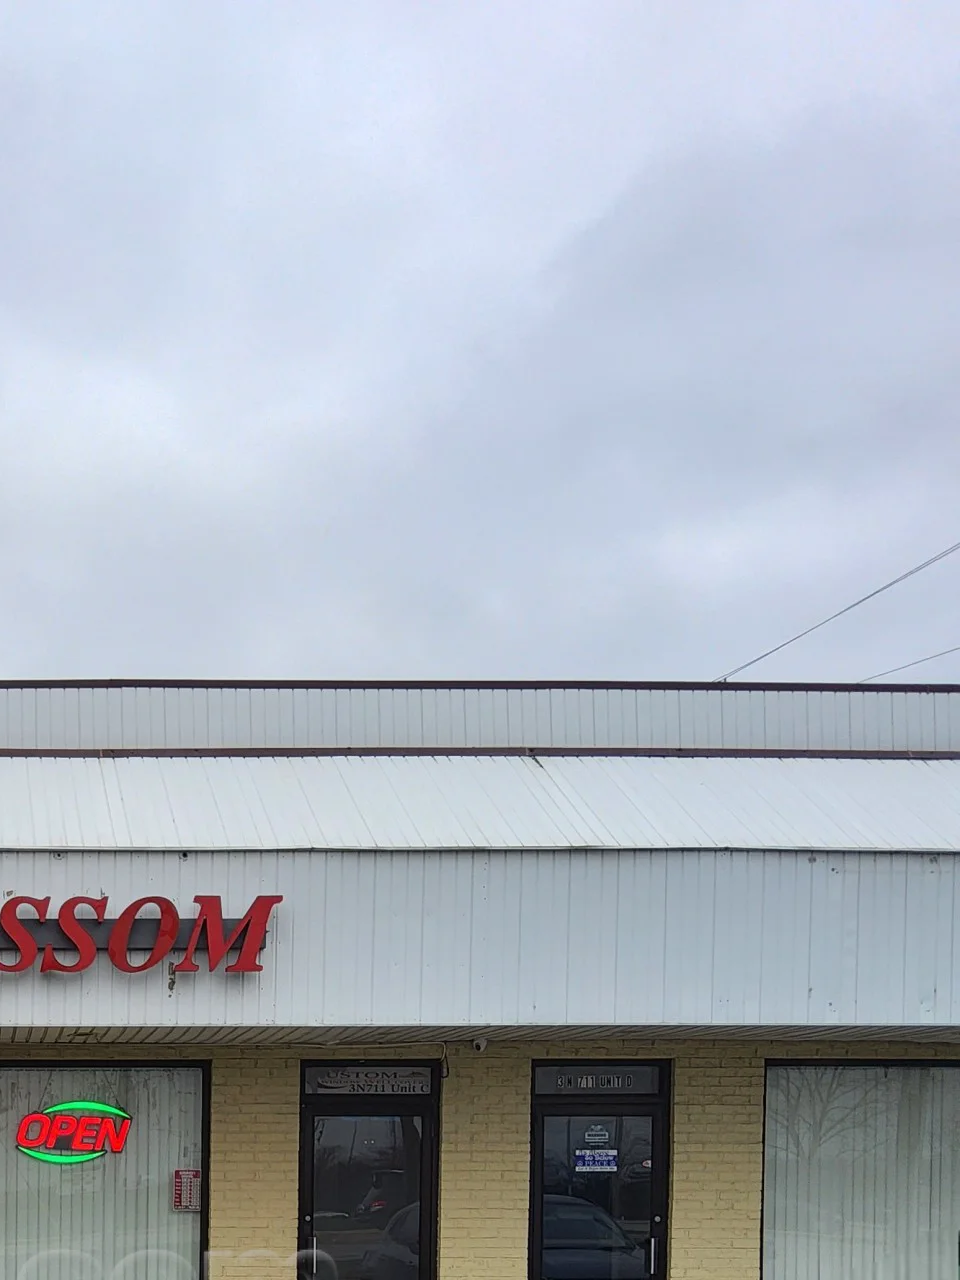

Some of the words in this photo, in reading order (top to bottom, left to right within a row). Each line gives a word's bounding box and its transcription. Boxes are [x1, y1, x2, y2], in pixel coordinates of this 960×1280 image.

[600, 1075, 621, 1088] UNIT
[348, 1084, 385, 1093] 3N711
[391, 1084, 416, 1093] Unit
[420, 1084, 429, 1093] C
[16, 1112, 131, 1153] OPEN
